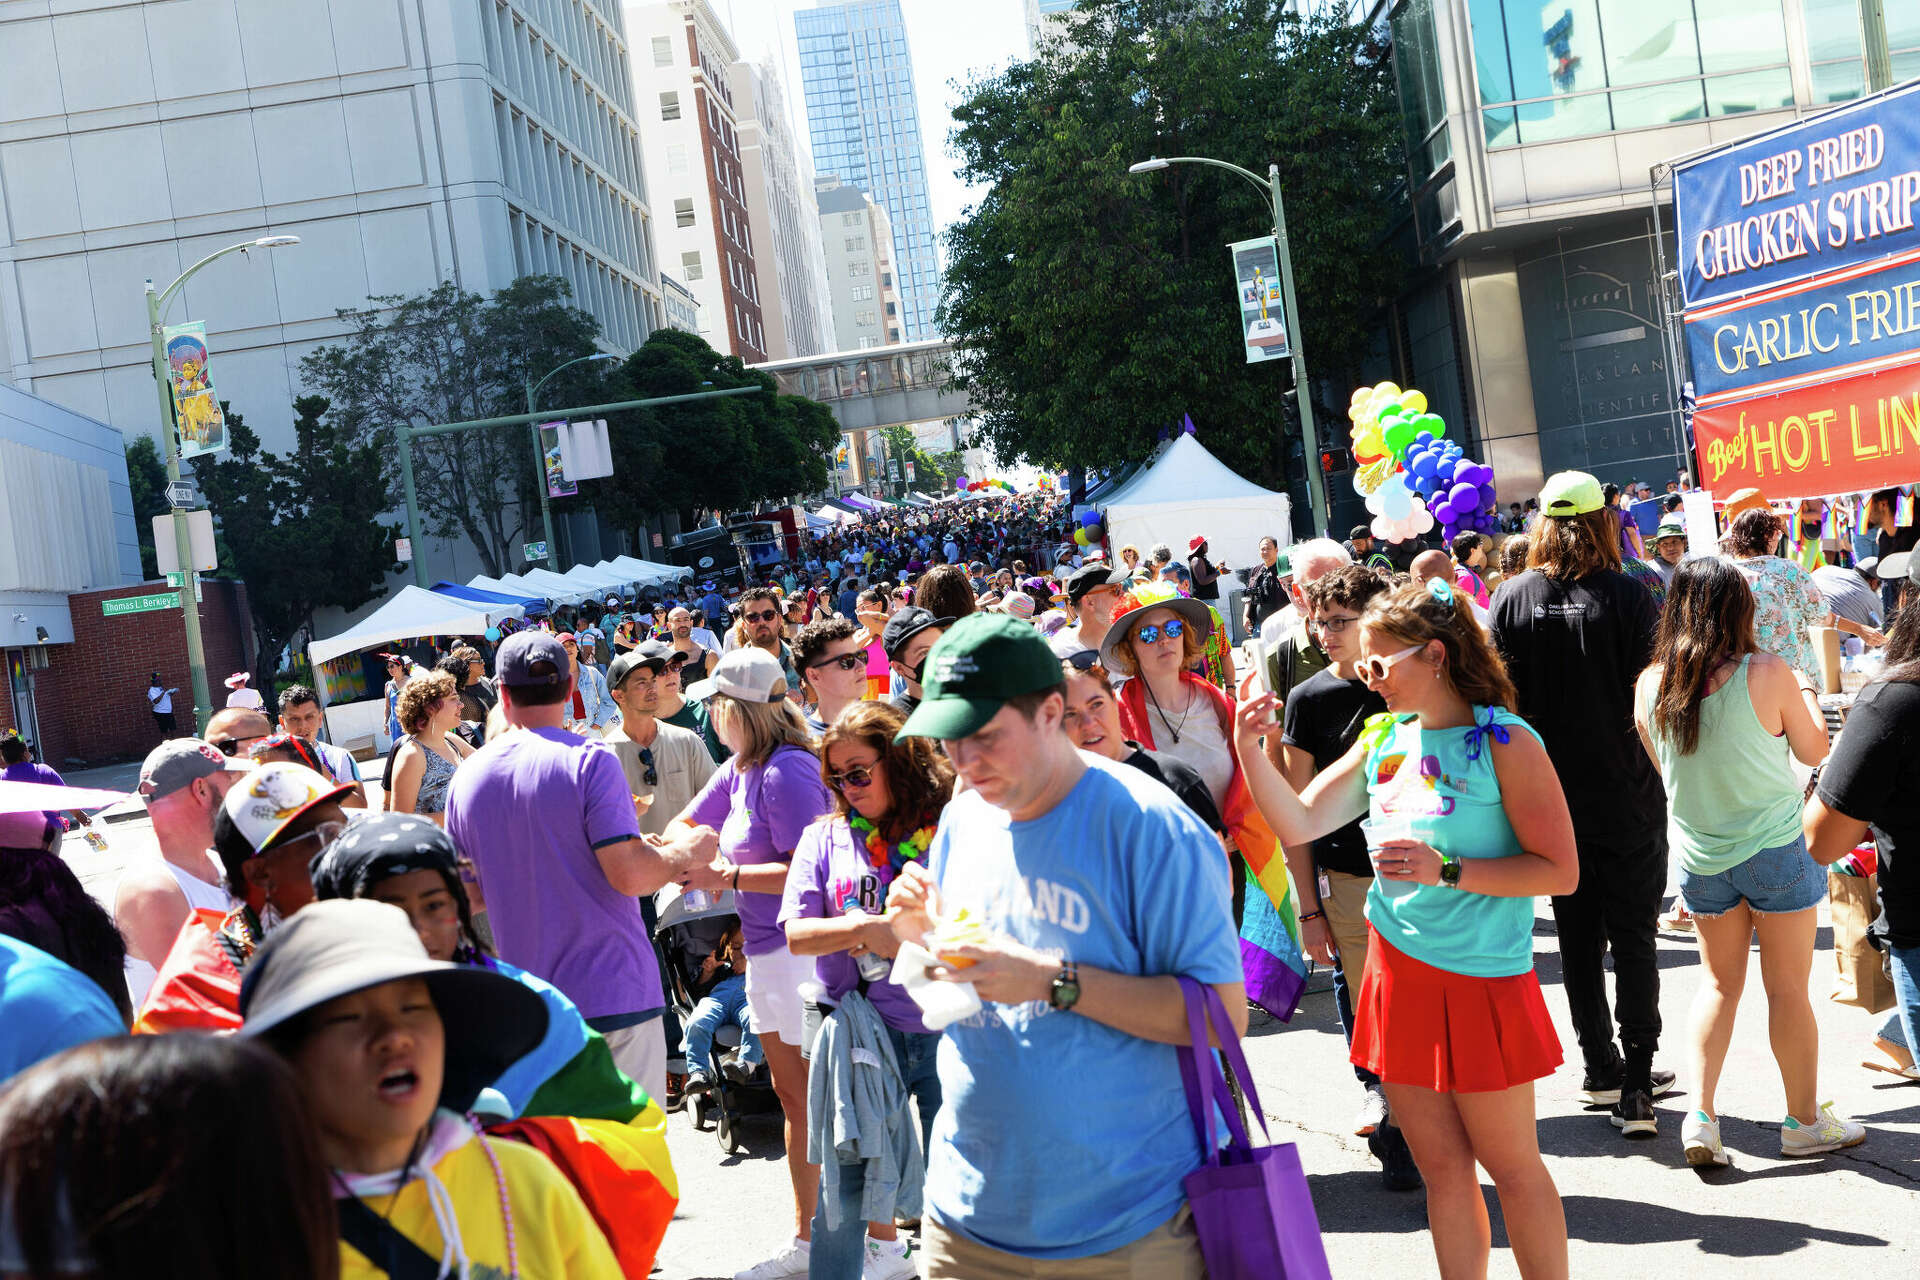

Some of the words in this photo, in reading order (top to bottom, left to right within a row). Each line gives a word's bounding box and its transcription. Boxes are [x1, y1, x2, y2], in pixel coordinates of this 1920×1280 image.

[1739, 149, 1802, 206] DEEP
[1807, 123, 1885, 186] FRIED
[1695, 199, 1821, 281] CHICKEN
[1827, 170, 1920, 249] STRIP
[1713, 302, 1840, 375] GARLIC
[1846, 280, 1920, 346] FRIE
[1707, 411, 1749, 482] Beef
[1750, 408, 1838, 478] HOT
[1850, 391, 1920, 462] LIN
[106, 602, 134, 612] Thomas
[142, 597, 171, 608] Berkley
